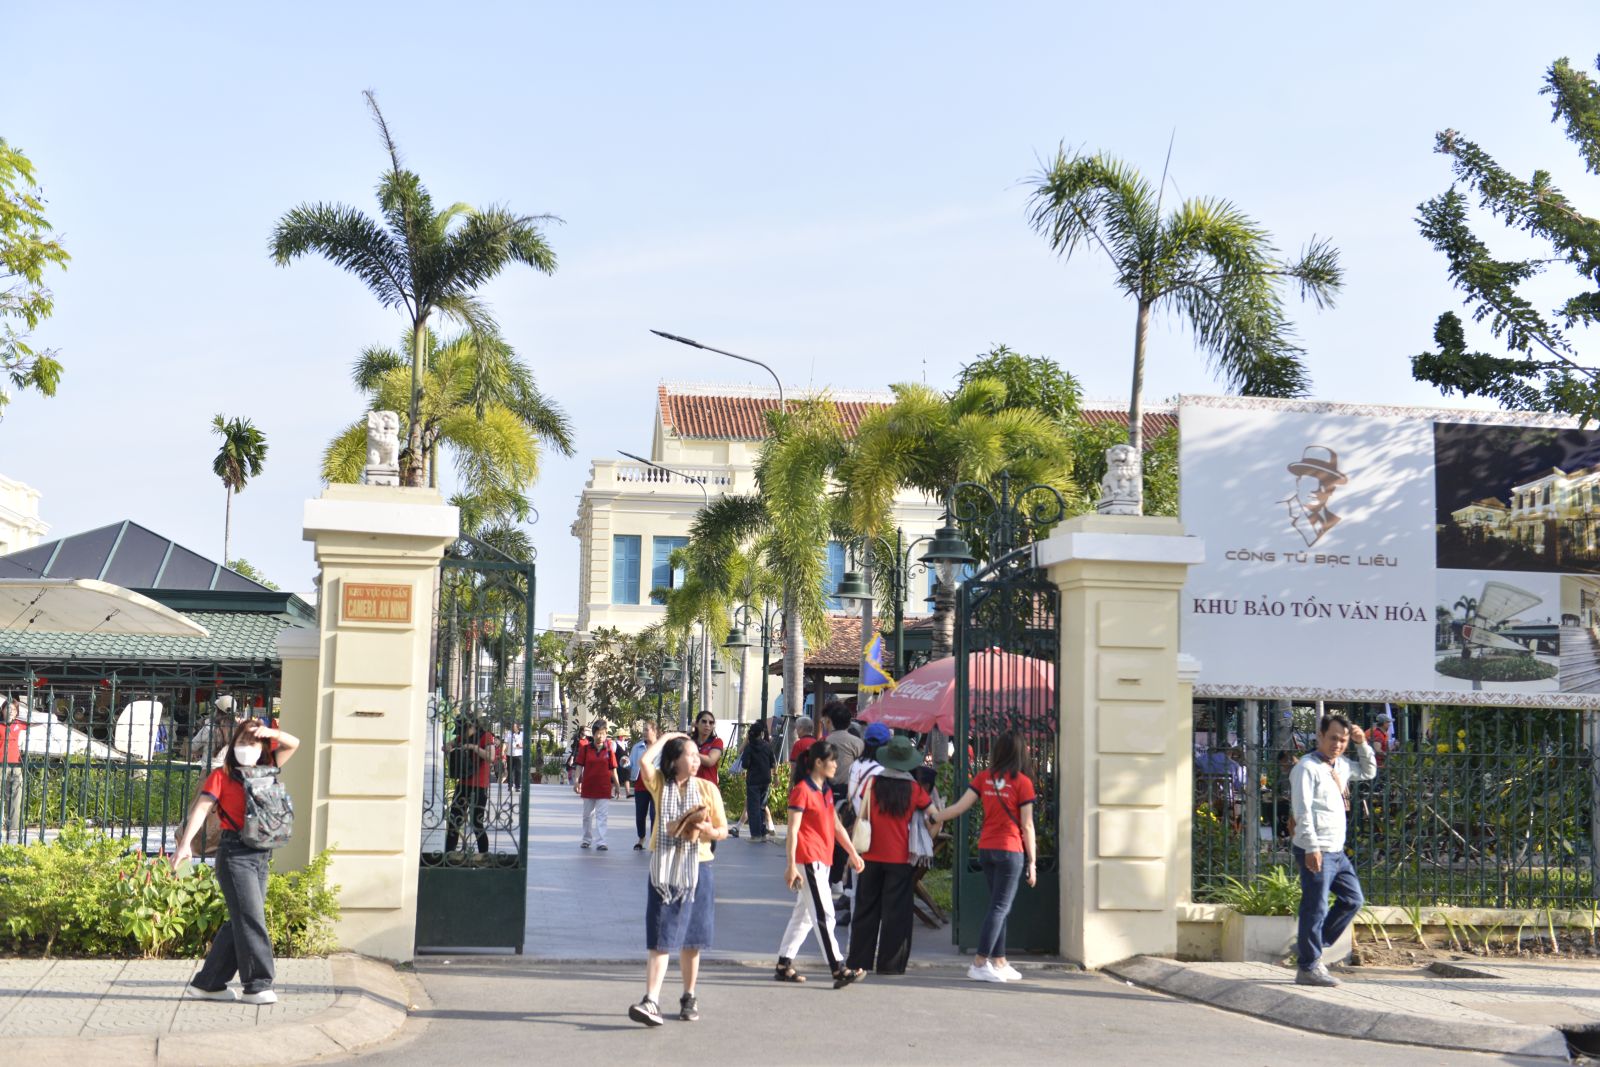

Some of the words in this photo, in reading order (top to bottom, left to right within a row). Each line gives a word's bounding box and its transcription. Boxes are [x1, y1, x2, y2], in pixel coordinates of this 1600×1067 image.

[1225, 549, 1276, 562] CÔNG
[1283, 551, 1307, 563] TỬ
[1315, 554, 1350, 568] BẠC
[1358, 554, 1398, 567] LIÊU
[348, 599, 377, 618] CAMERA
[380, 600, 389, 619] AN
[391, 600, 408, 619] NINH
[1193, 599, 1237, 615] KHU
[1245, 595, 1285, 617] BẢO
[1291, 595, 1332, 618] TỒN
[1338, 601, 1379, 620] VĂN
[1385, 602, 1428, 622] HÓA
